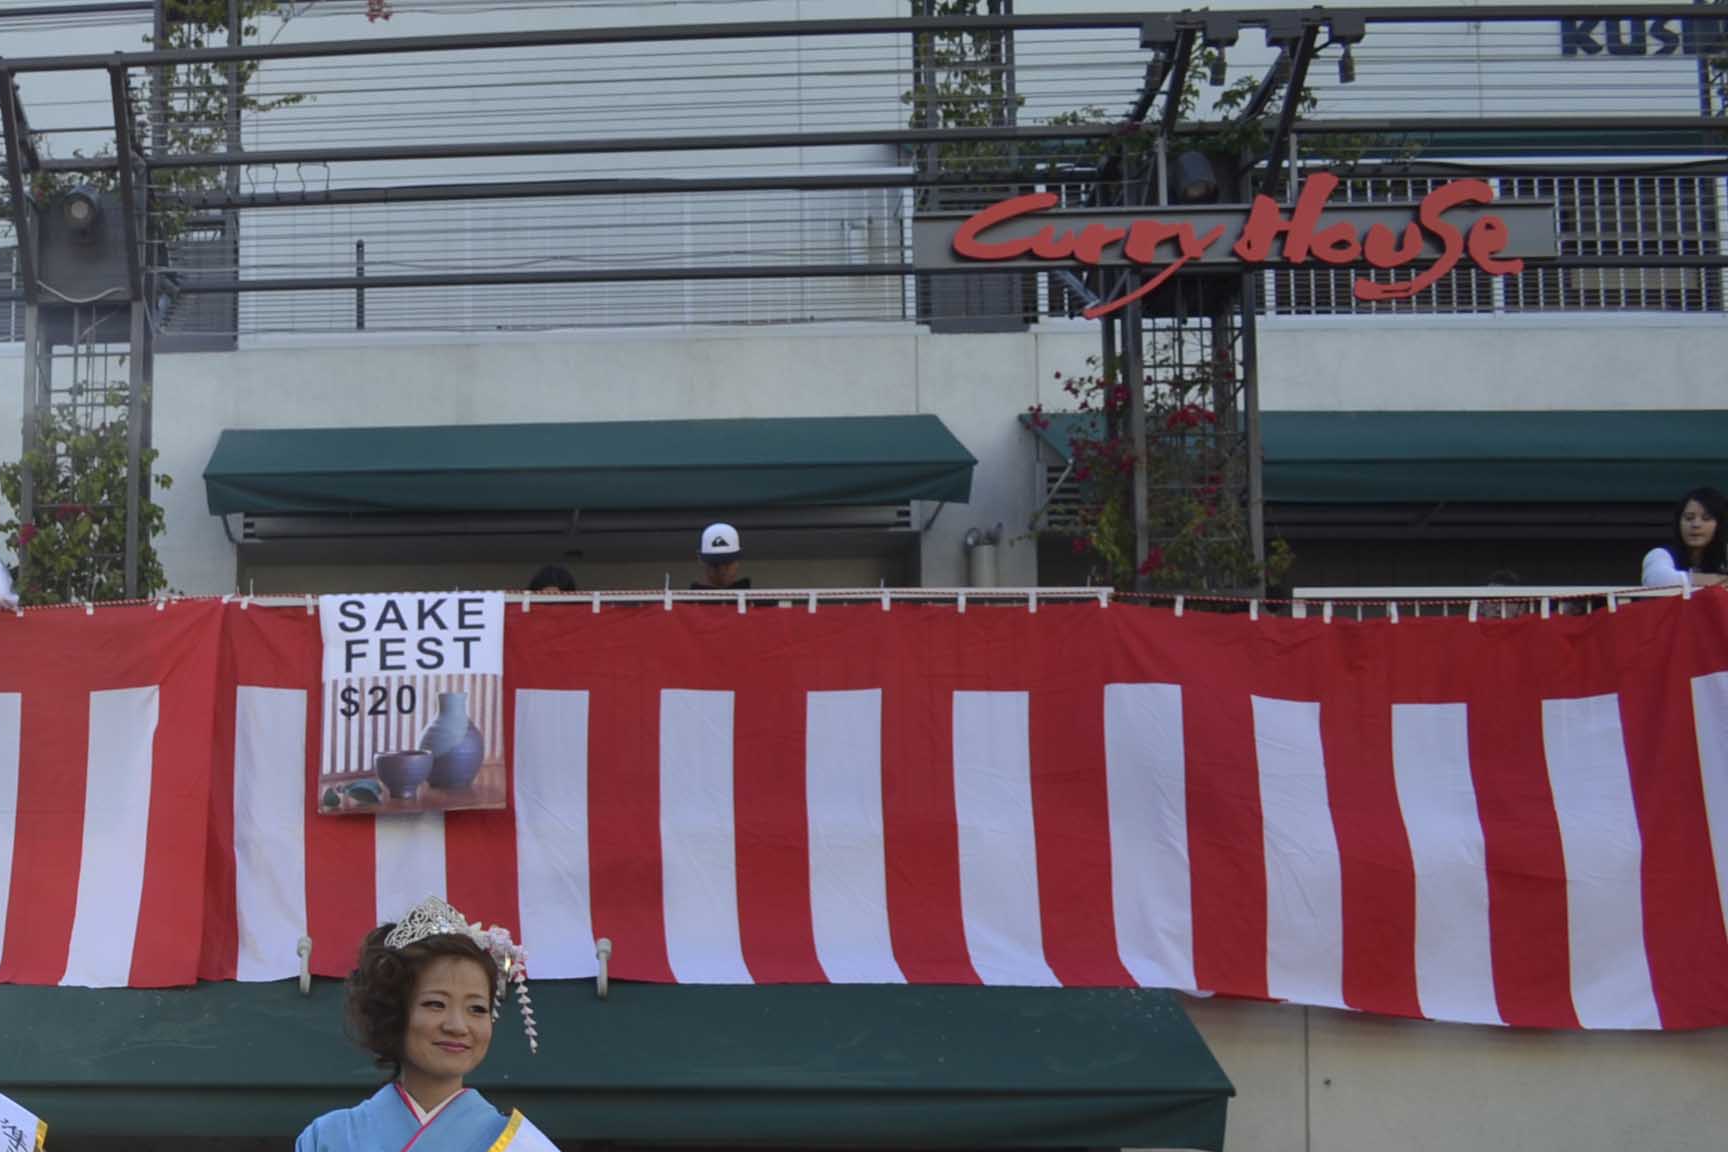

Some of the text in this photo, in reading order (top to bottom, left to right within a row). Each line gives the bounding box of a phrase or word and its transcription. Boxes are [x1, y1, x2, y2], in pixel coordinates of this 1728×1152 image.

[953, 192, 1224, 319] Curry
[338, 598, 485, 633] SAKE
[345, 637, 481, 673] FEST
[339, 684, 416, 720] $20
